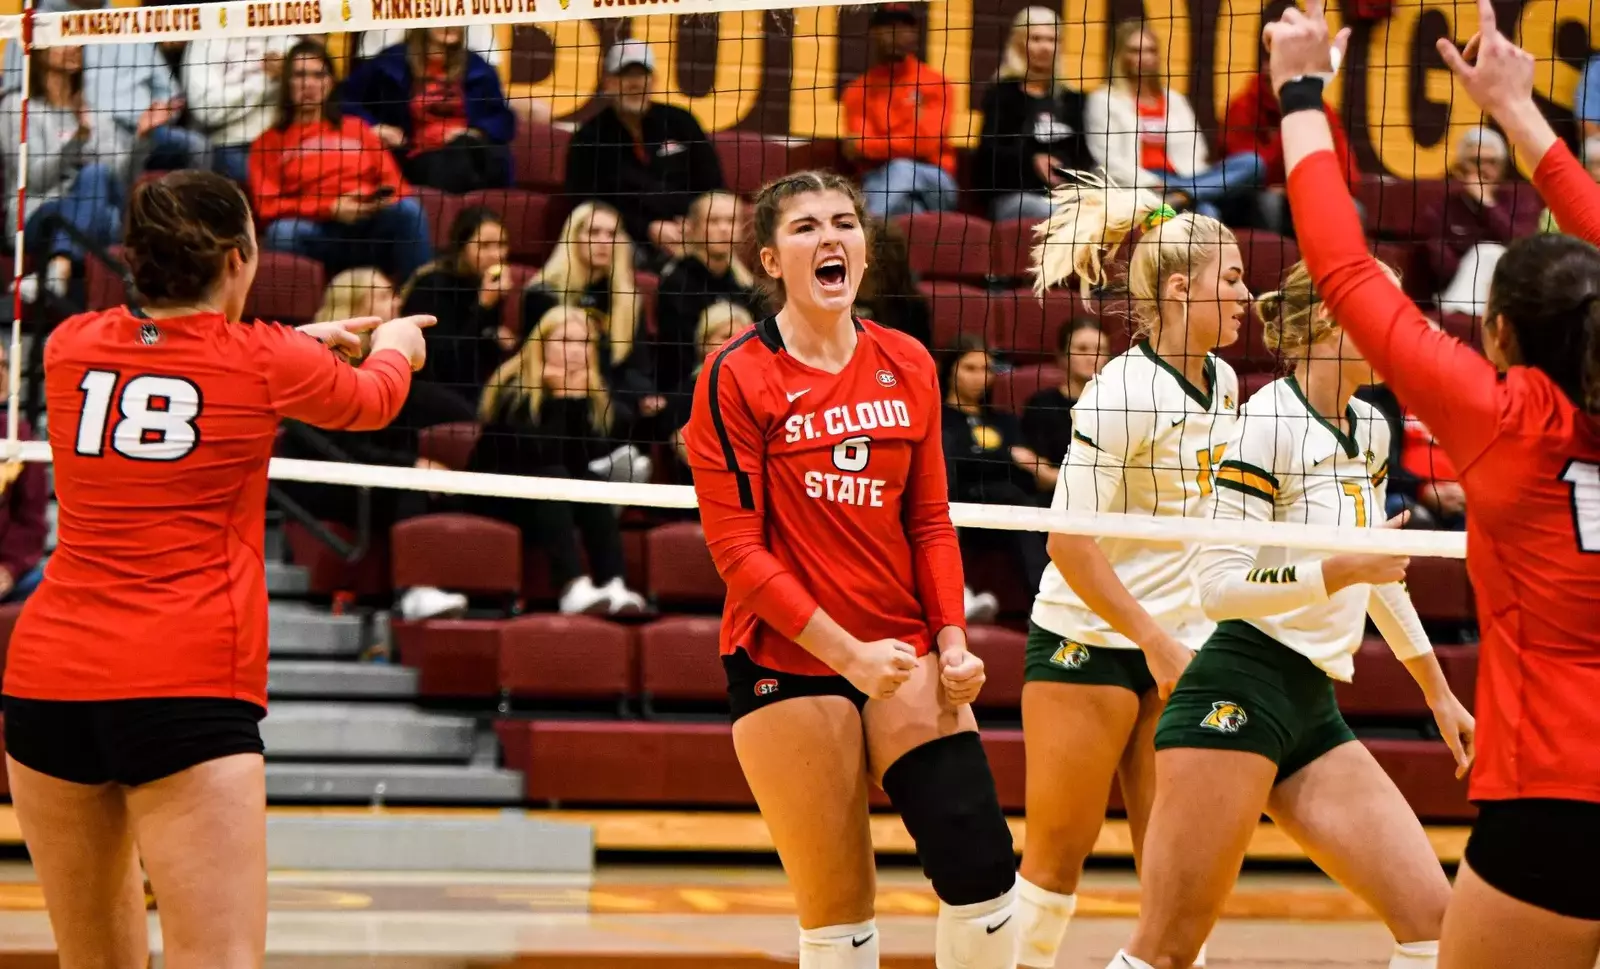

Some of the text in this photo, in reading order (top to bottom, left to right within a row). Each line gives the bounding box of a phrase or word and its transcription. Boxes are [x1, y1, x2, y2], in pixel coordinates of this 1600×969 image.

[61, 11, 139, 37] MINNESOTA
[247, 1, 322, 27] BULLDOGS
[75, 368, 204, 462] 18
[784, 399, 911, 443] ST. CLOUD
[831, 435, 874, 472] 6
[804, 470, 887, 507] STATE
